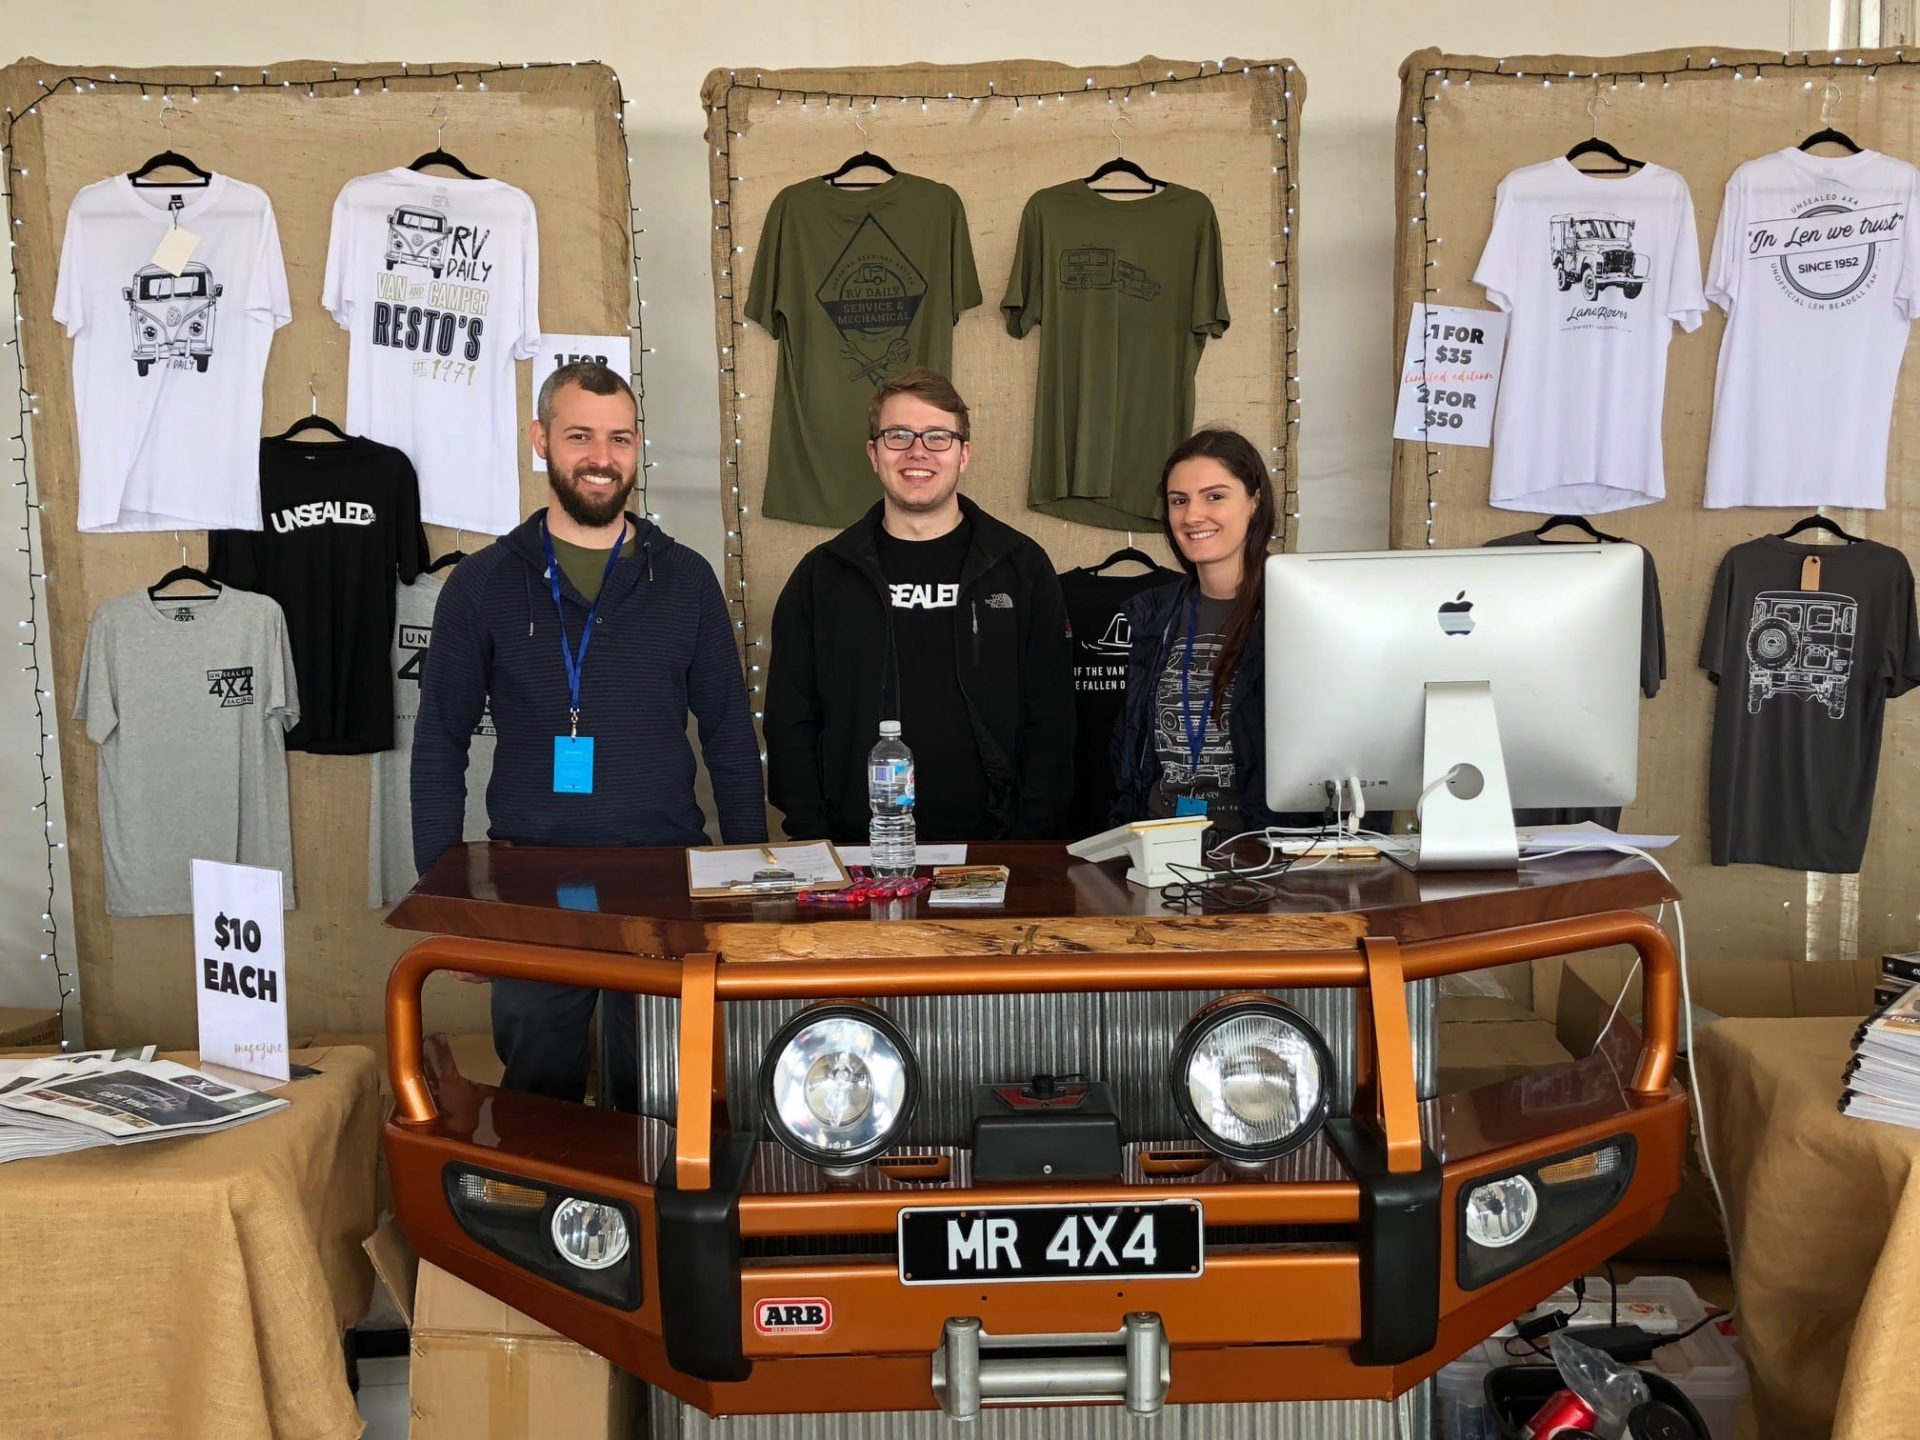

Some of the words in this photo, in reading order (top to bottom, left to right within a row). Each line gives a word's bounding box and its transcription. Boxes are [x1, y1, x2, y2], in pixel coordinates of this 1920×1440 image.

[1791, 194, 1837, 214] UNSEALED
[451, 226, 490, 259] RV
[1784, 226, 1823, 248] Len
[1826, 224, 1855, 240] we
[447, 258, 492, 282] DAILY
[1798, 260, 1833, 274] SINCE
[1835, 257, 1859, 271] 1952
[377, 272, 407, 302] VAN
[428, 281, 489, 316] CAMPER
[846, 288, 862, 299] RV
[867, 287, 900, 297] DAILY
[1770, 263, 1805, 306] UNOFFICIAL
[1807, 301, 1825, 311] LEN
[1829, 290, 1866, 310] BEADELL
[843, 302, 893, 313] SERVICE
[838, 312, 911, 325] MECHANICAL
[373, 301, 483, 361] RESTO'S
[1430, 324, 1440, 340] 1
[1443, 326, 1484, 344] FOR
[173, 360, 195, 370] DAILY
[554, 353, 563, 368] 1
[1435, 345, 1472, 365] $35
[432, 358, 476, 386] 1971
[1452, 368, 1495, 382] edition
[1417, 388, 1431, 404] 2
[1434, 390, 1476, 409] FOR
[1424, 408, 1463, 429] $50
[270, 501, 374, 533] UNSEALED
[1085, 666, 1103, 677] THE
[208, 677, 254, 698] 4X4
[1083, 680, 1117, 690] FALLEN
[214, 911, 261, 953] $10
[203, 958, 278, 1003] EACH
[234, 1041, 284, 1063] magazine
[947, 1217, 1022, 1271] MR
[1045, 1213, 1157, 1267] 4X4
[765, 1305, 824, 1326] ARB
